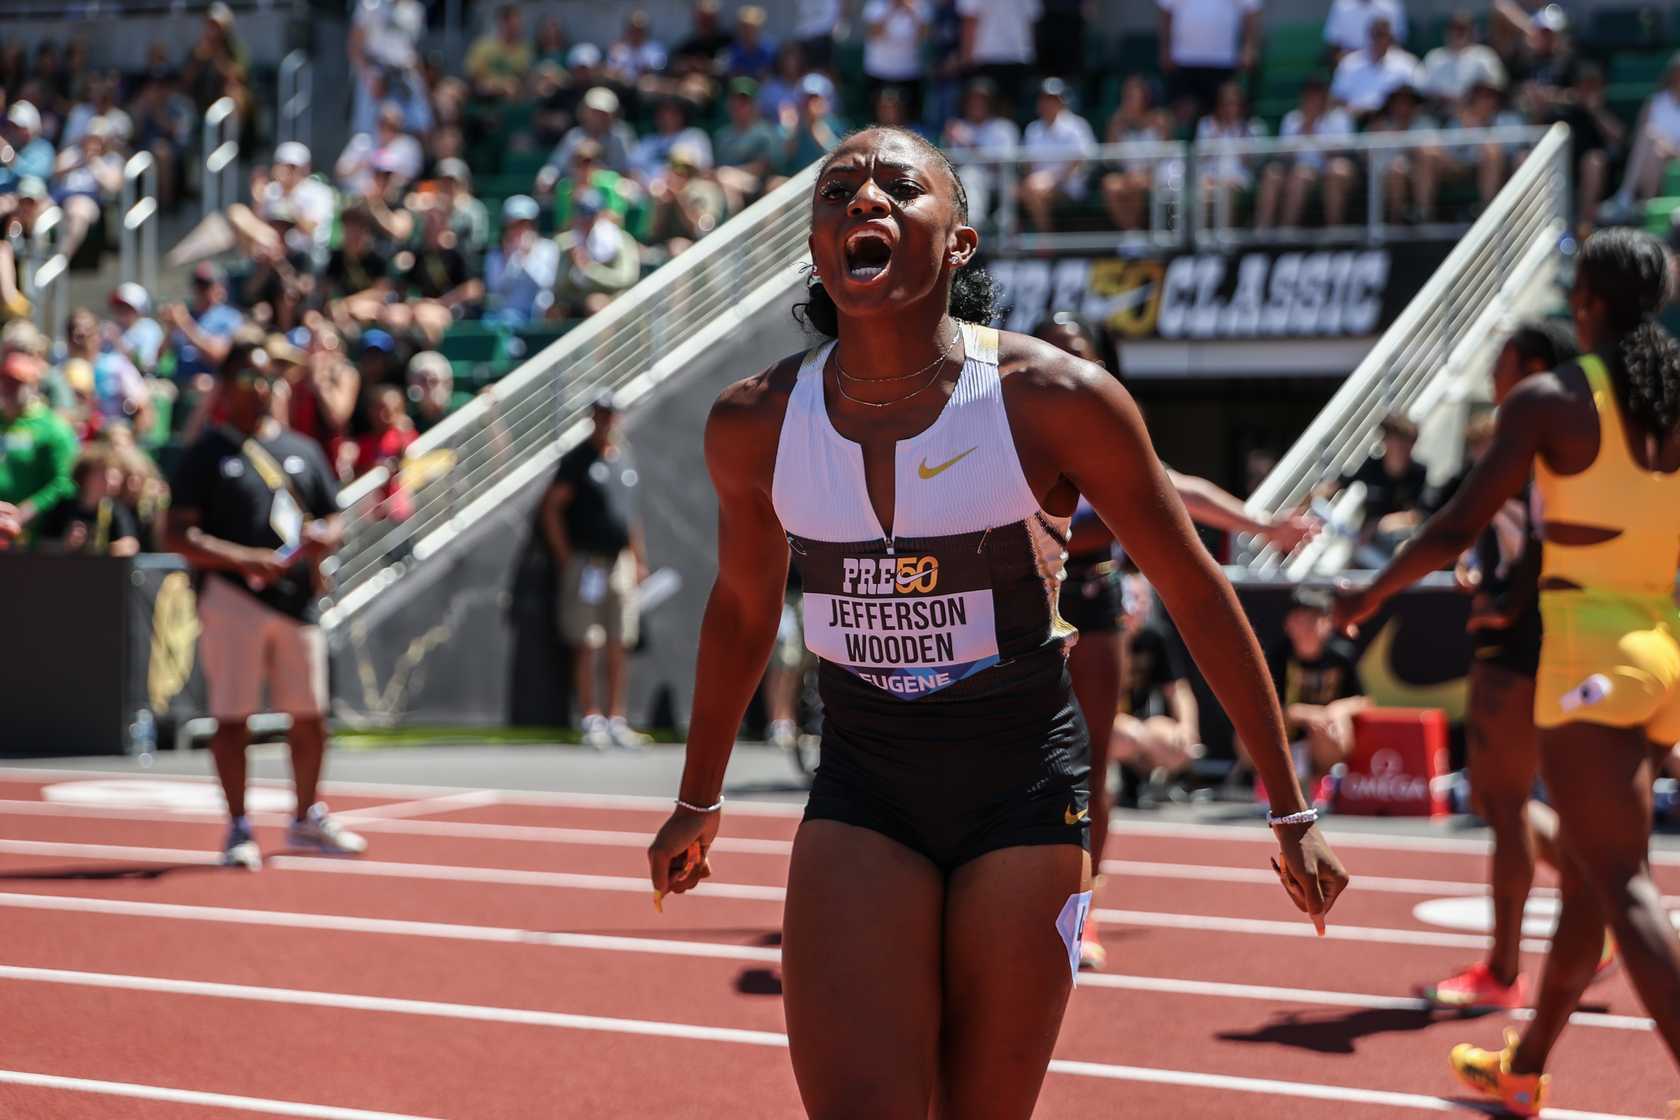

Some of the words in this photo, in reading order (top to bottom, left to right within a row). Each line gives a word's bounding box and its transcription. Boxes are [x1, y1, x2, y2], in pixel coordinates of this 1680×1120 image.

[1156, 249, 1392, 338] CLASSIC
[829, 597, 967, 631] JEFFERSON
[845, 632, 955, 664] WOODEN
[859, 672, 951, 694] EUGENE
